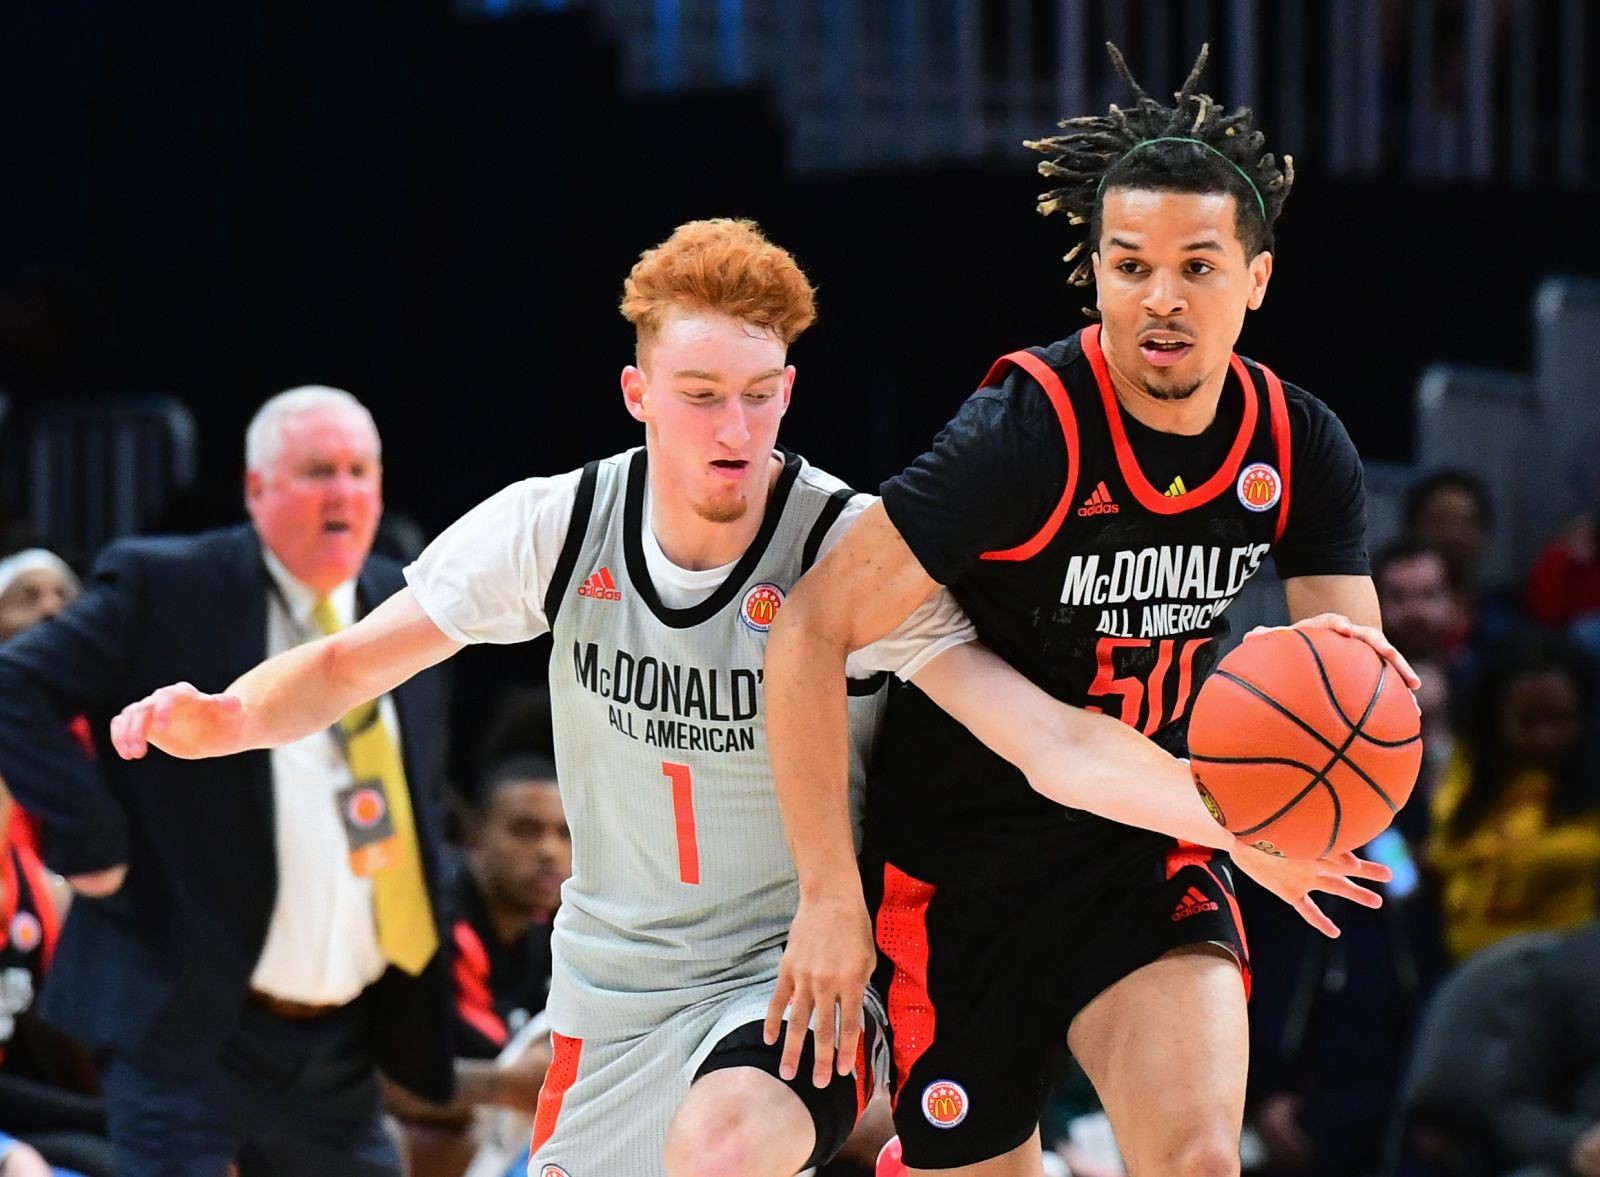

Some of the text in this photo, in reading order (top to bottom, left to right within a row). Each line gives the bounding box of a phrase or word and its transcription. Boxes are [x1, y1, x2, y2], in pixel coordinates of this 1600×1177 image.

[1077, 502, 1119, 517] addas
[577, 585, 622, 601] adidas
[1095, 606, 1134, 639] ALL
[573, 640, 764, 723] McDONALD'
[609, 704, 756, 753] ALL AMERICAN
[661, 761, 701, 886] 1
[1171, 901, 1219, 922] adidas
